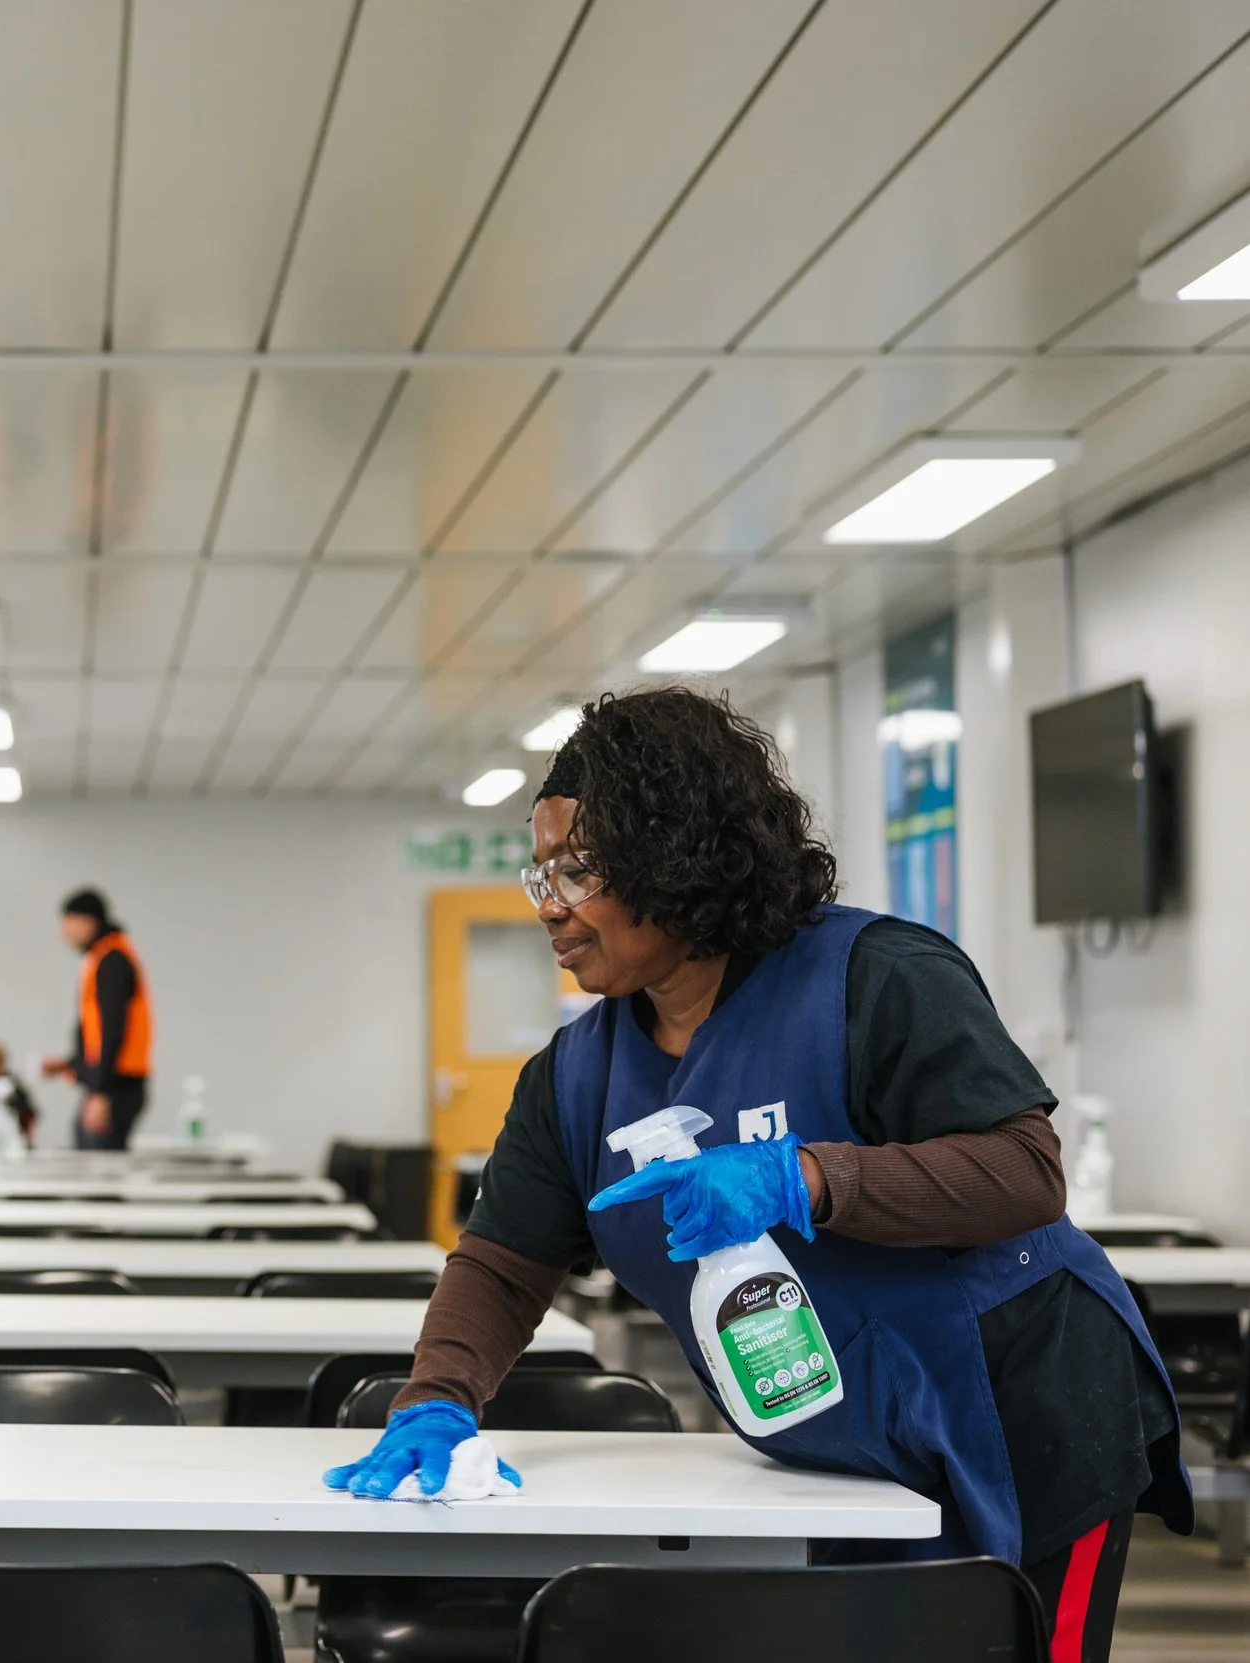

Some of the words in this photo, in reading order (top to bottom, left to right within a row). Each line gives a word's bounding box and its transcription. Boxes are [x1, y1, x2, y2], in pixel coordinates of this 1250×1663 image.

[752, 1111, 777, 1142] J
[742, 1285, 770, 1304] Super
[779, 1285, 798, 1303] C11
[734, 1314, 786, 1344] Anti-bacterial
[737, 1327, 788, 1355] Sanitiser
